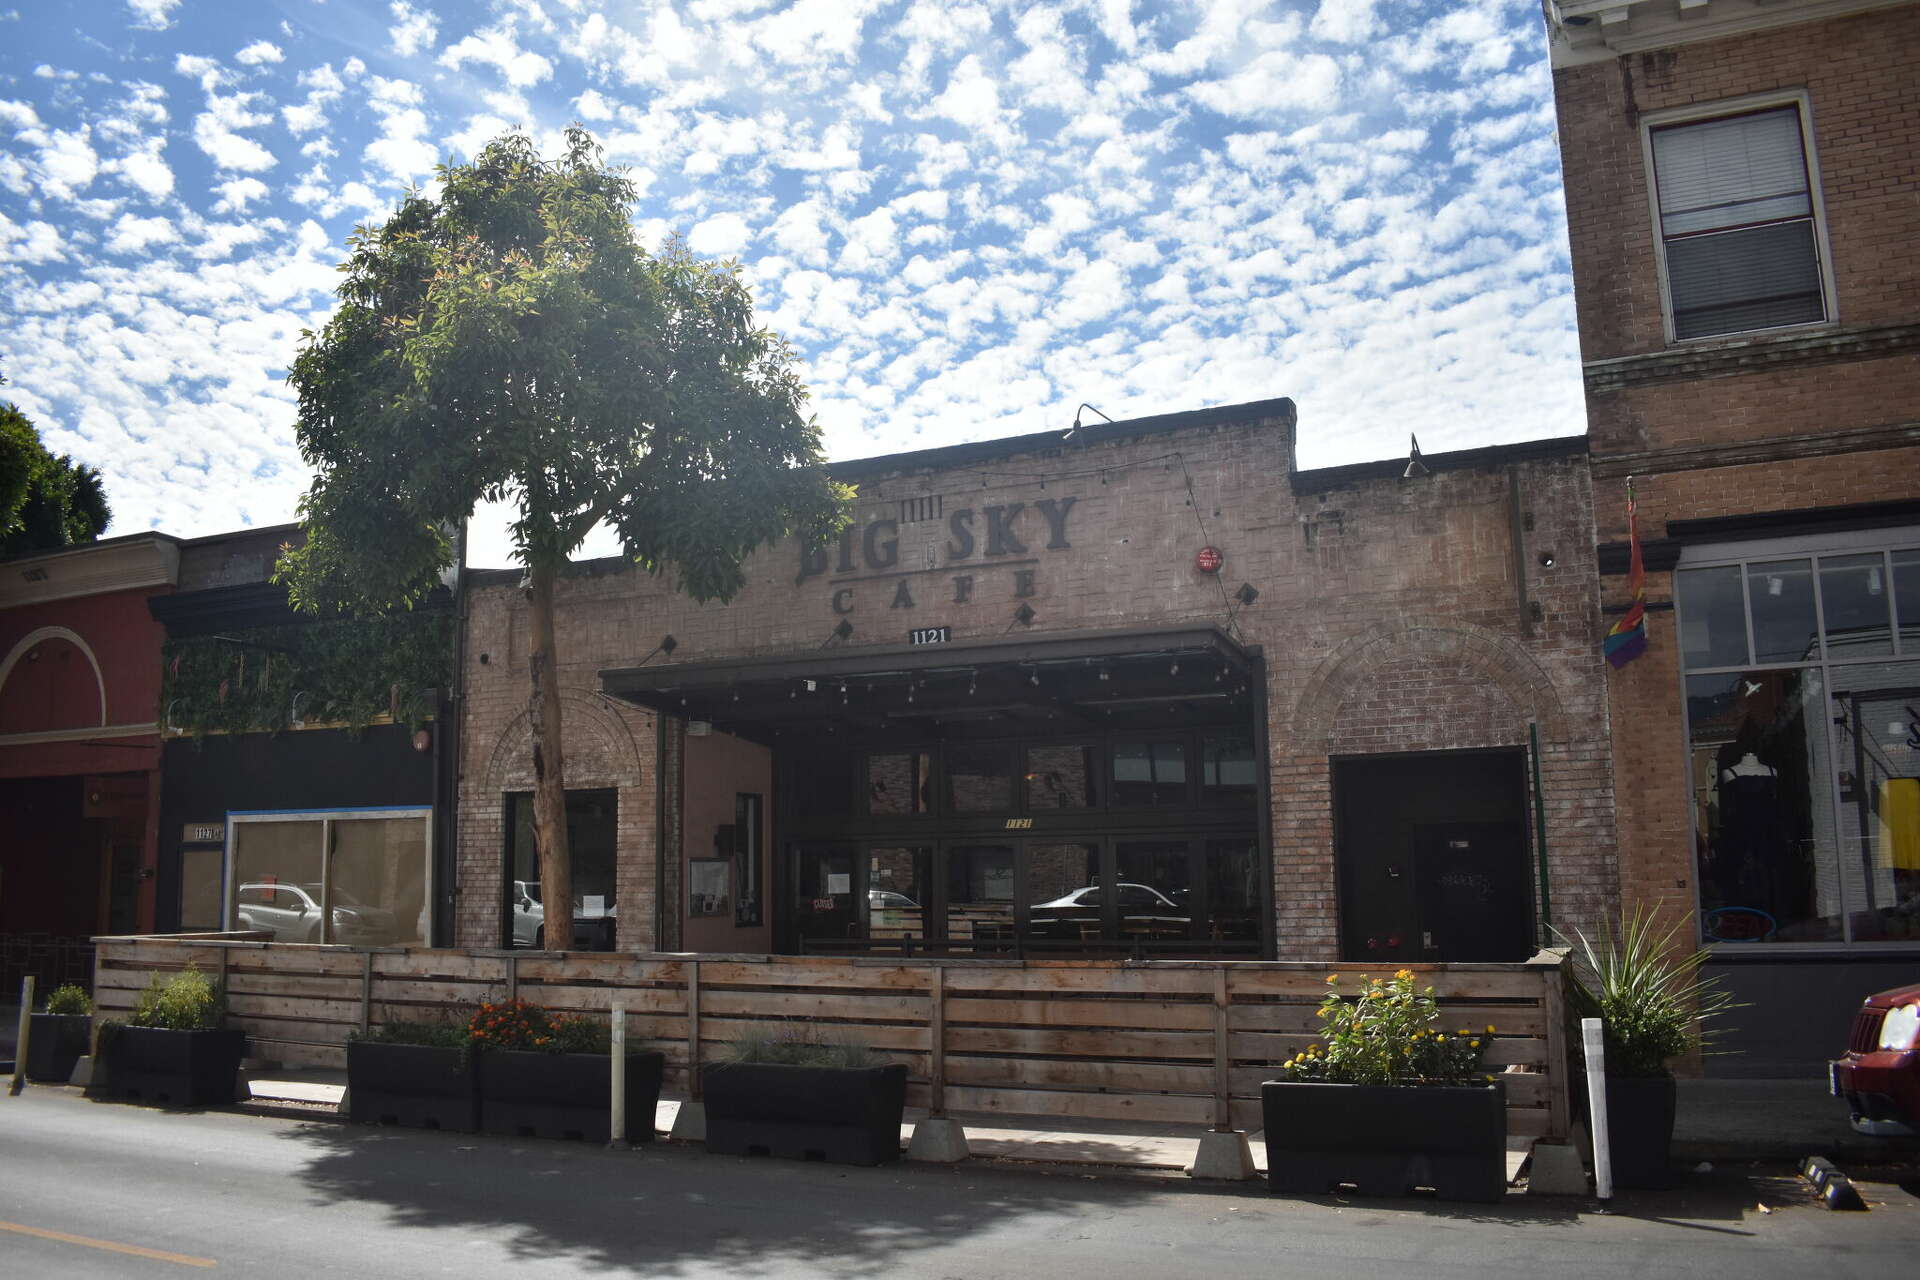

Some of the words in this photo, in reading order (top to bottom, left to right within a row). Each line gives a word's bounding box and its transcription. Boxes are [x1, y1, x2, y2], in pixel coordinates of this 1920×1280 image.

[798, 520, 898, 577] BIG
[947, 496, 1077, 560] SKY
[831, 569, 1036, 615] CAFE
[913, 628, 945, 645] 1121
[1004, 818, 1032, 829] 1121
